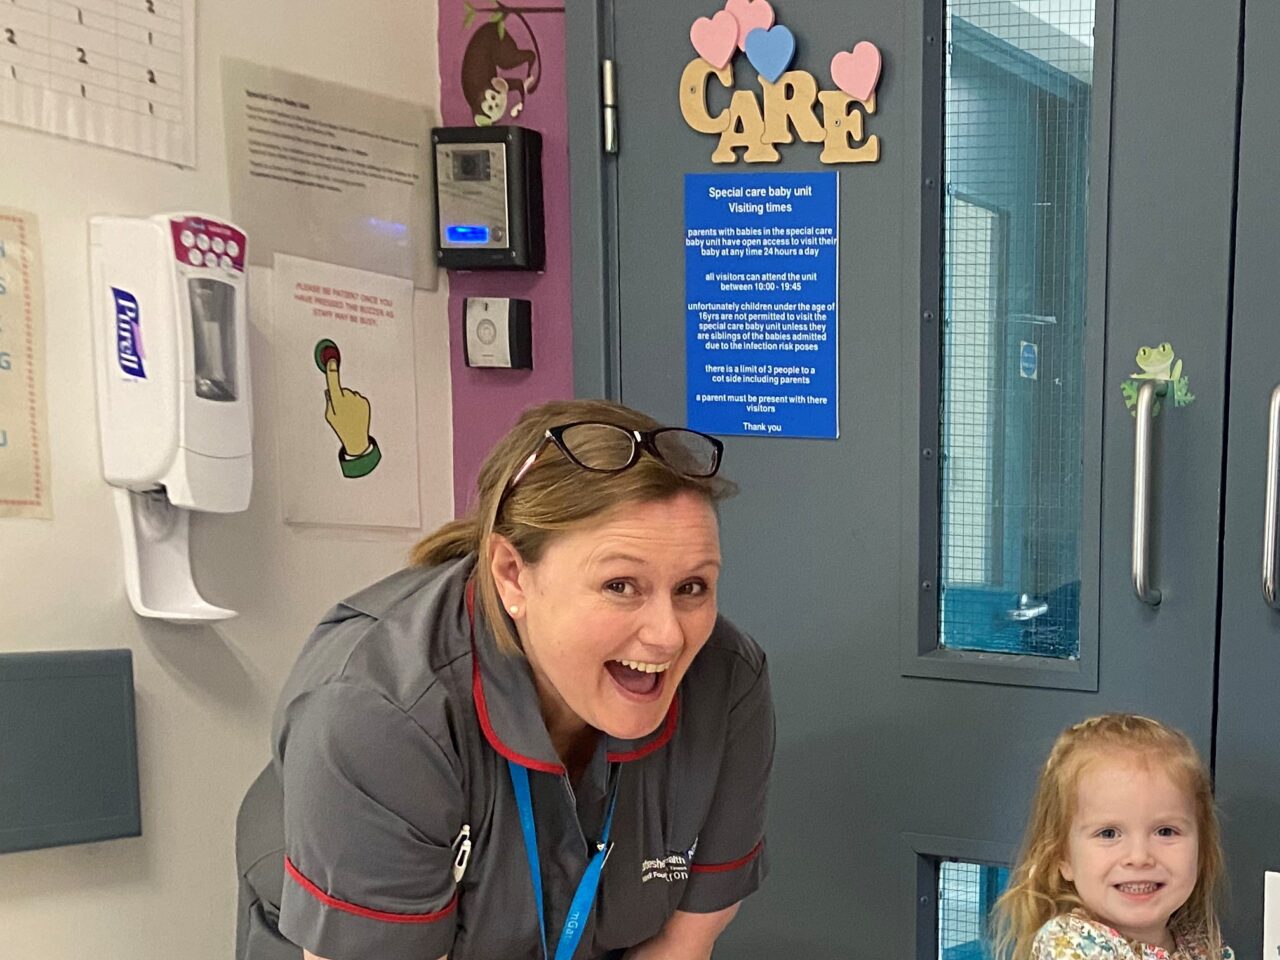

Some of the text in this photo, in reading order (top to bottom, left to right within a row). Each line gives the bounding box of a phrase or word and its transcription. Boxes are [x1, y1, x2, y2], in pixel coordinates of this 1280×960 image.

[5, 28, 17, 45] 2
[77, 47, 88, 64] 2
[147, 69, 157, 84] 2
[679, 58, 880, 163] CARE
[709, 186, 811, 199] Special care baby unit
[729, 202, 792, 214] Visiting times
[688, 228, 717, 237] parents
[786, 227, 814, 236] special
[686, 238, 704, 248] baby
[742, 239, 761, 247] open
[800, 237, 817, 245] visit
[702, 248, 720, 257] baby
[805, 248, 819, 257] day
[706, 273, 715, 281] all
[716, 273, 744, 281] visitors
[761, 273, 786, 281] attend
[788, 273, 800, 281] the
[802, 273, 817, 281] unit
[688, 303, 739, 312] unfortunately
[812, 304, 825, 313] age
[827, 302, 835, 310] of
[699, 313, 719, 321] 16yrs
[749, 313, 785, 322] permitted
[699, 322, 725, 331] special
[746, 322, 764, 331] baby
[766, 322, 780, 330] unit
[782, 322, 807, 330] unless
[809, 322, 826, 332] they
[118, 298, 138, 369] Purell
[711, 332, 740, 341] siblings
[742, 332, 750, 340] of
[752, 332, 763, 340] the
[765, 332, 791, 340] babies
[743, 342, 777, 350] infection
[779, 342, 793, 350] risk
[795, 344, 818, 352] poses
[740, 365, 757, 373] limit
[774, 366, 800, 375] people
[743, 375, 778, 385] including
[780, 377, 810, 385] parents
[789, 395, 805, 403] with
[807, 396, 827, 404] there
[743, 422, 781, 433] Thank you
